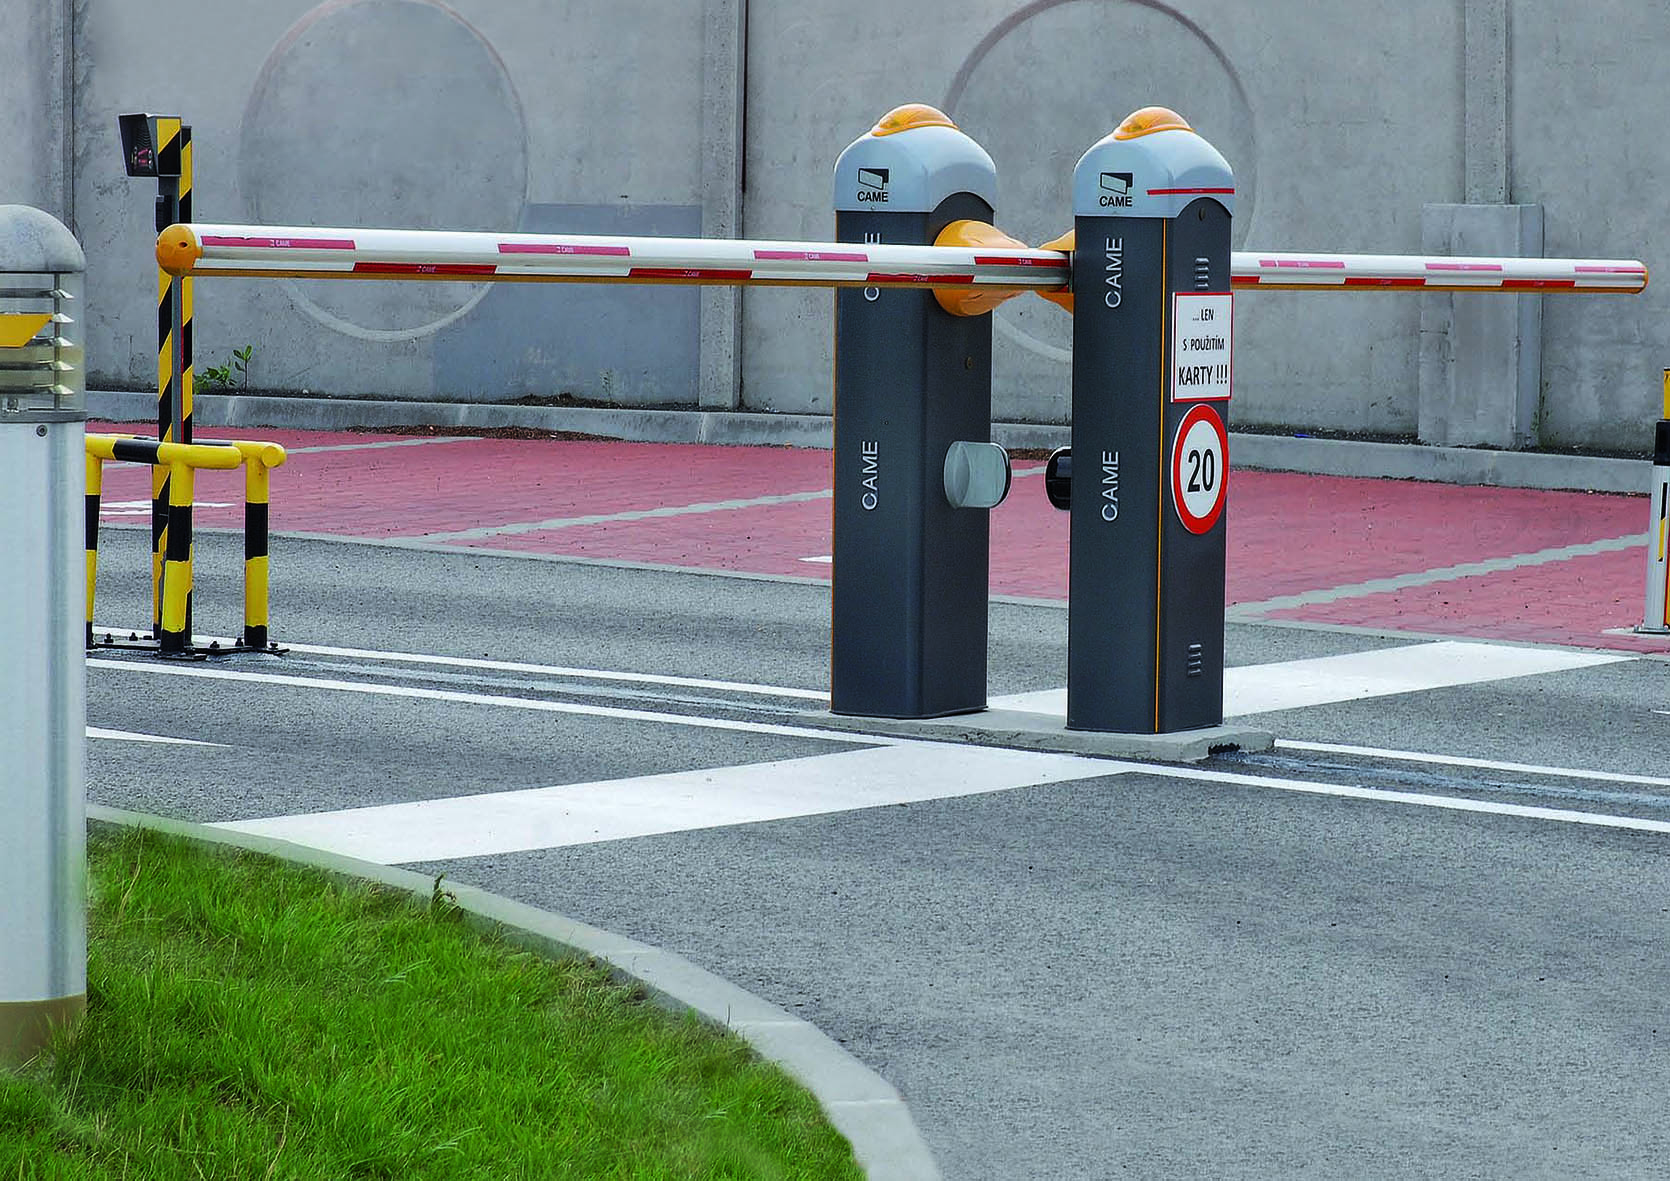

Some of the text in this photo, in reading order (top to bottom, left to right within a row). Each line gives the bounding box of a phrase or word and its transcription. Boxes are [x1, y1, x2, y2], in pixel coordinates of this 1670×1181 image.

[857, 191, 888, 203] CAME
[1099, 196, 1133, 207] CAME
[1105, 237, 1122, 308] CAME
[1183, 335, 1225, 351] S POUŽITÍM
[1178, 364, 1228, 386] KARTY !!!
[862, 441, 878, 510] CAME
[1102, 450, 1119, 521] CAME
[1187, 448, 1215, 493] 20
